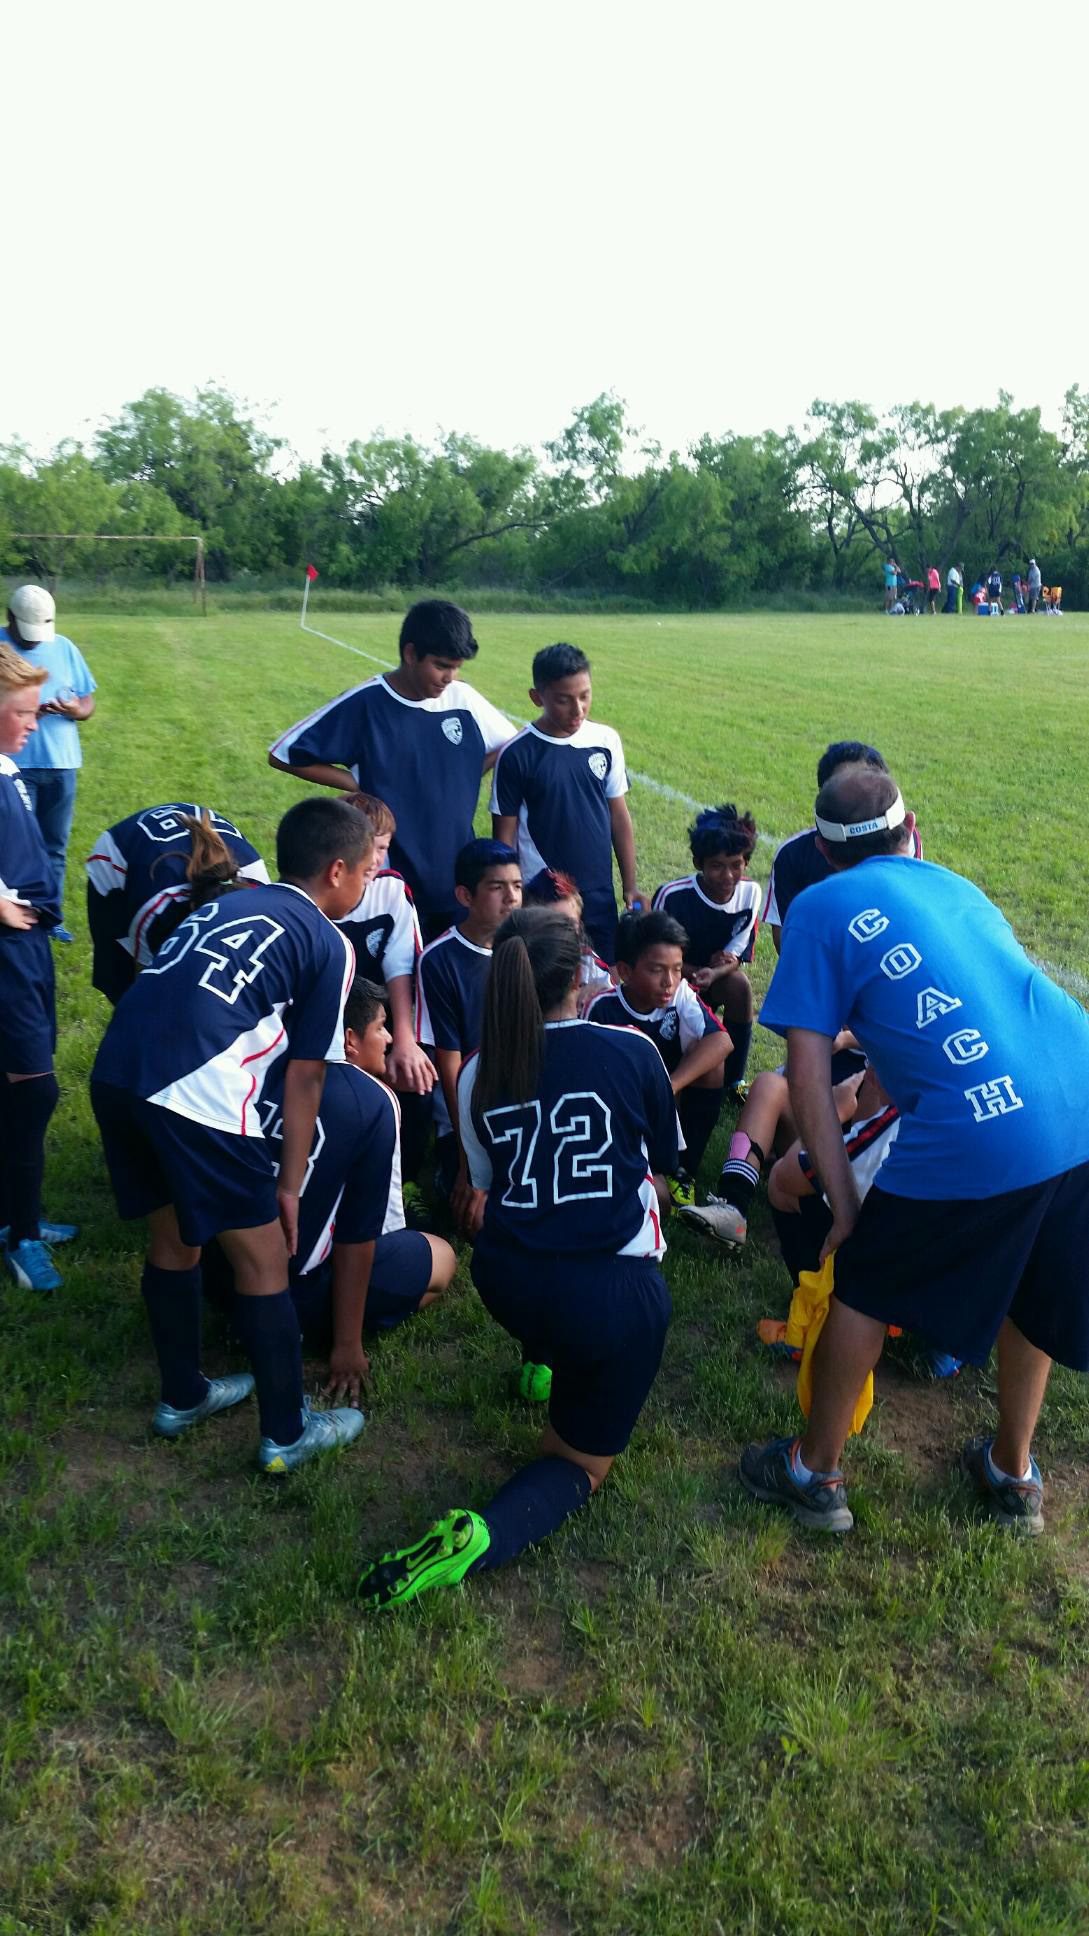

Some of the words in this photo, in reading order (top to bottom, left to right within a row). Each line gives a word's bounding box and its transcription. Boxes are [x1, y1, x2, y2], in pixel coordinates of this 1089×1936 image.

[849, 822, 878, 834] COSTA
[140, 902, 286, 1005] 64
[848, 908, 1024, 1123] COACH
[483, 1091, 612, 1208] 72
